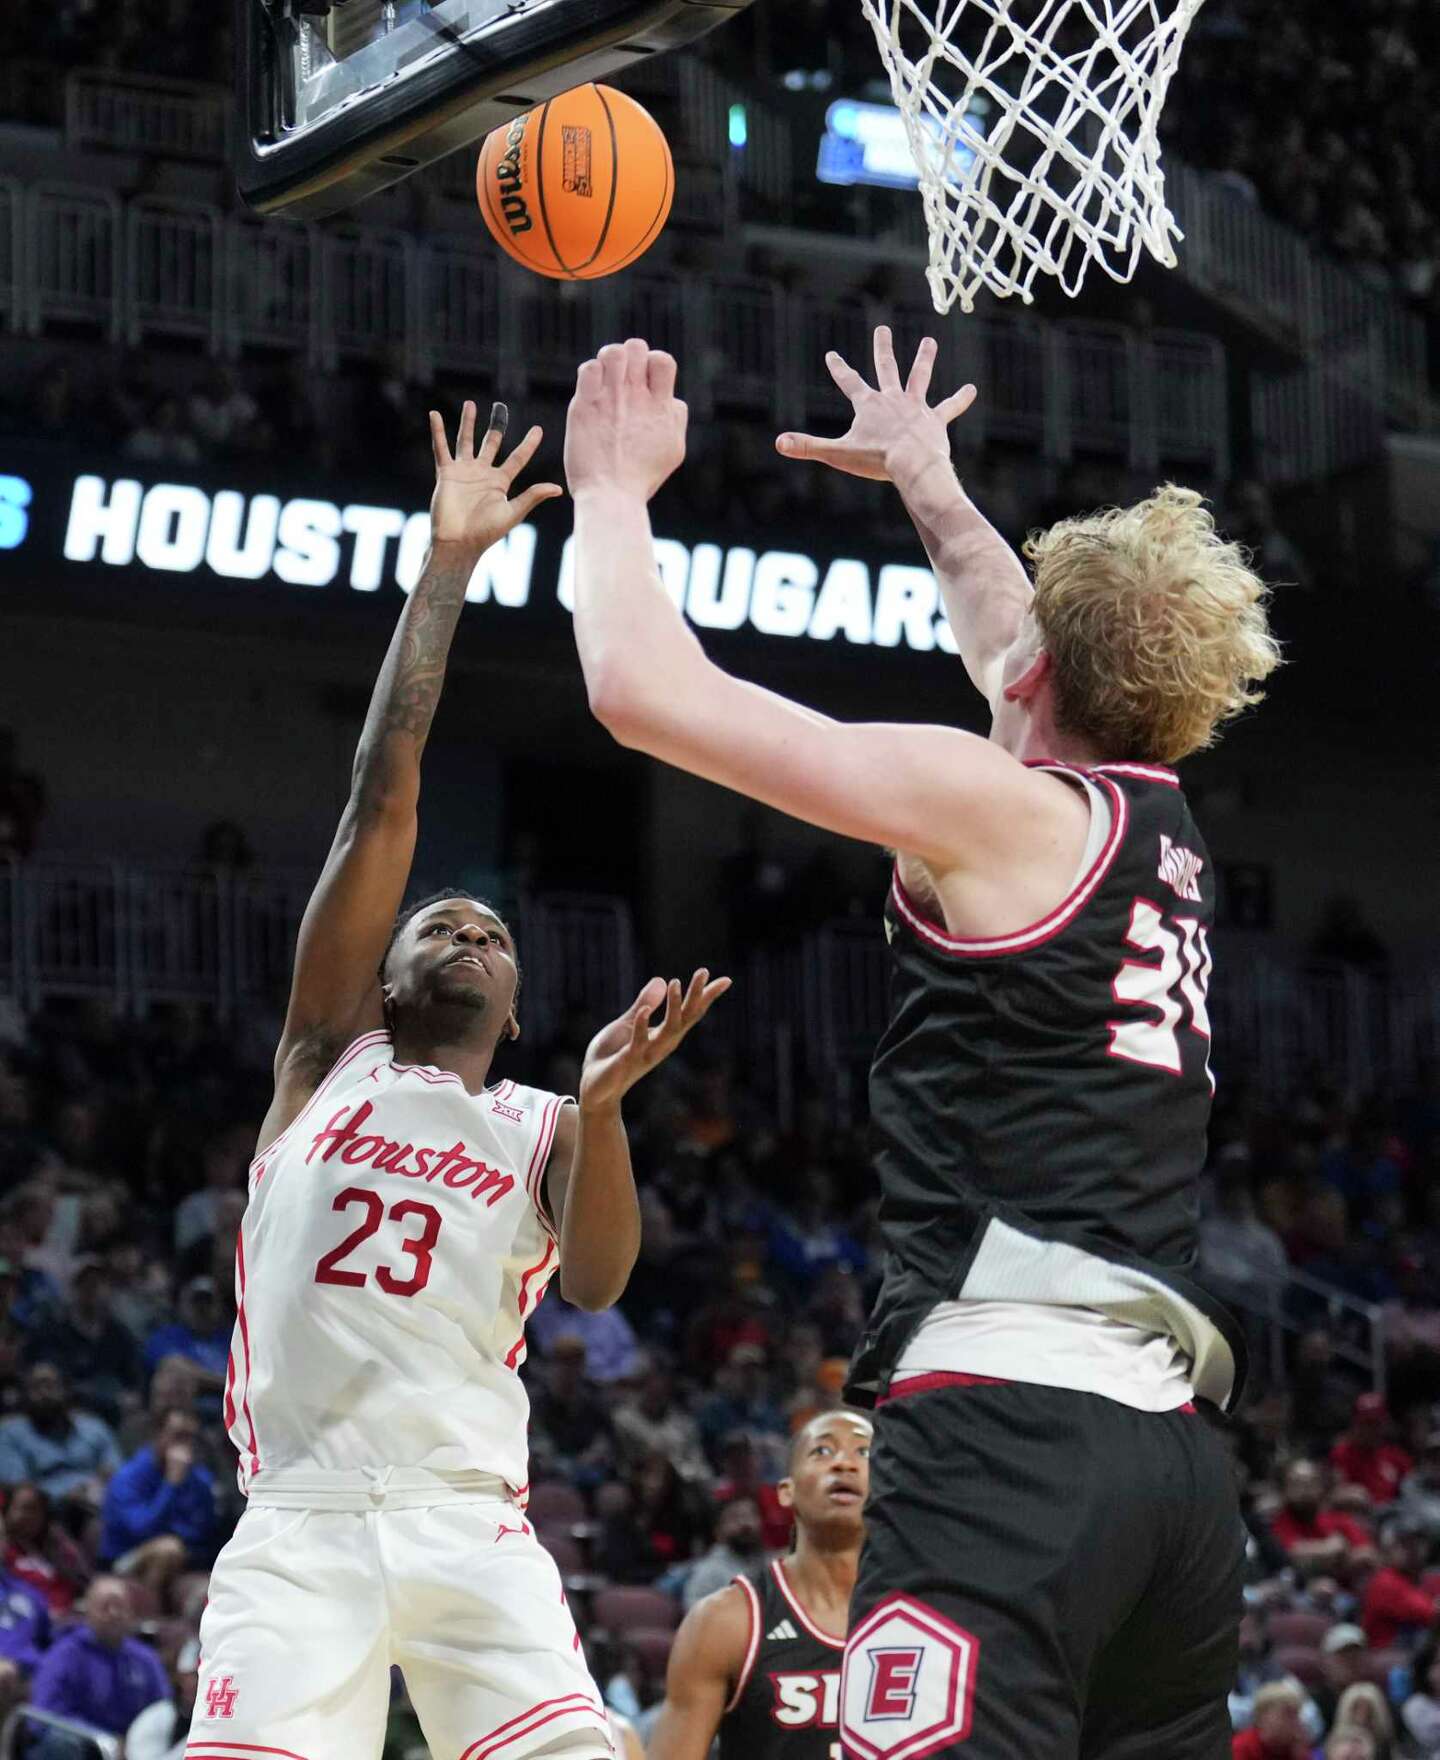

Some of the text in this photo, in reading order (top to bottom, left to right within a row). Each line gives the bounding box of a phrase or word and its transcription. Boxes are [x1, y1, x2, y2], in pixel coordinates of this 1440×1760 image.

[557, 535, 961, 655] UGAR
[305, 1099, 515, 1208] Houston
[315, 1187, 442, 1297] 23
[864, 1647, 925, 1722] E
